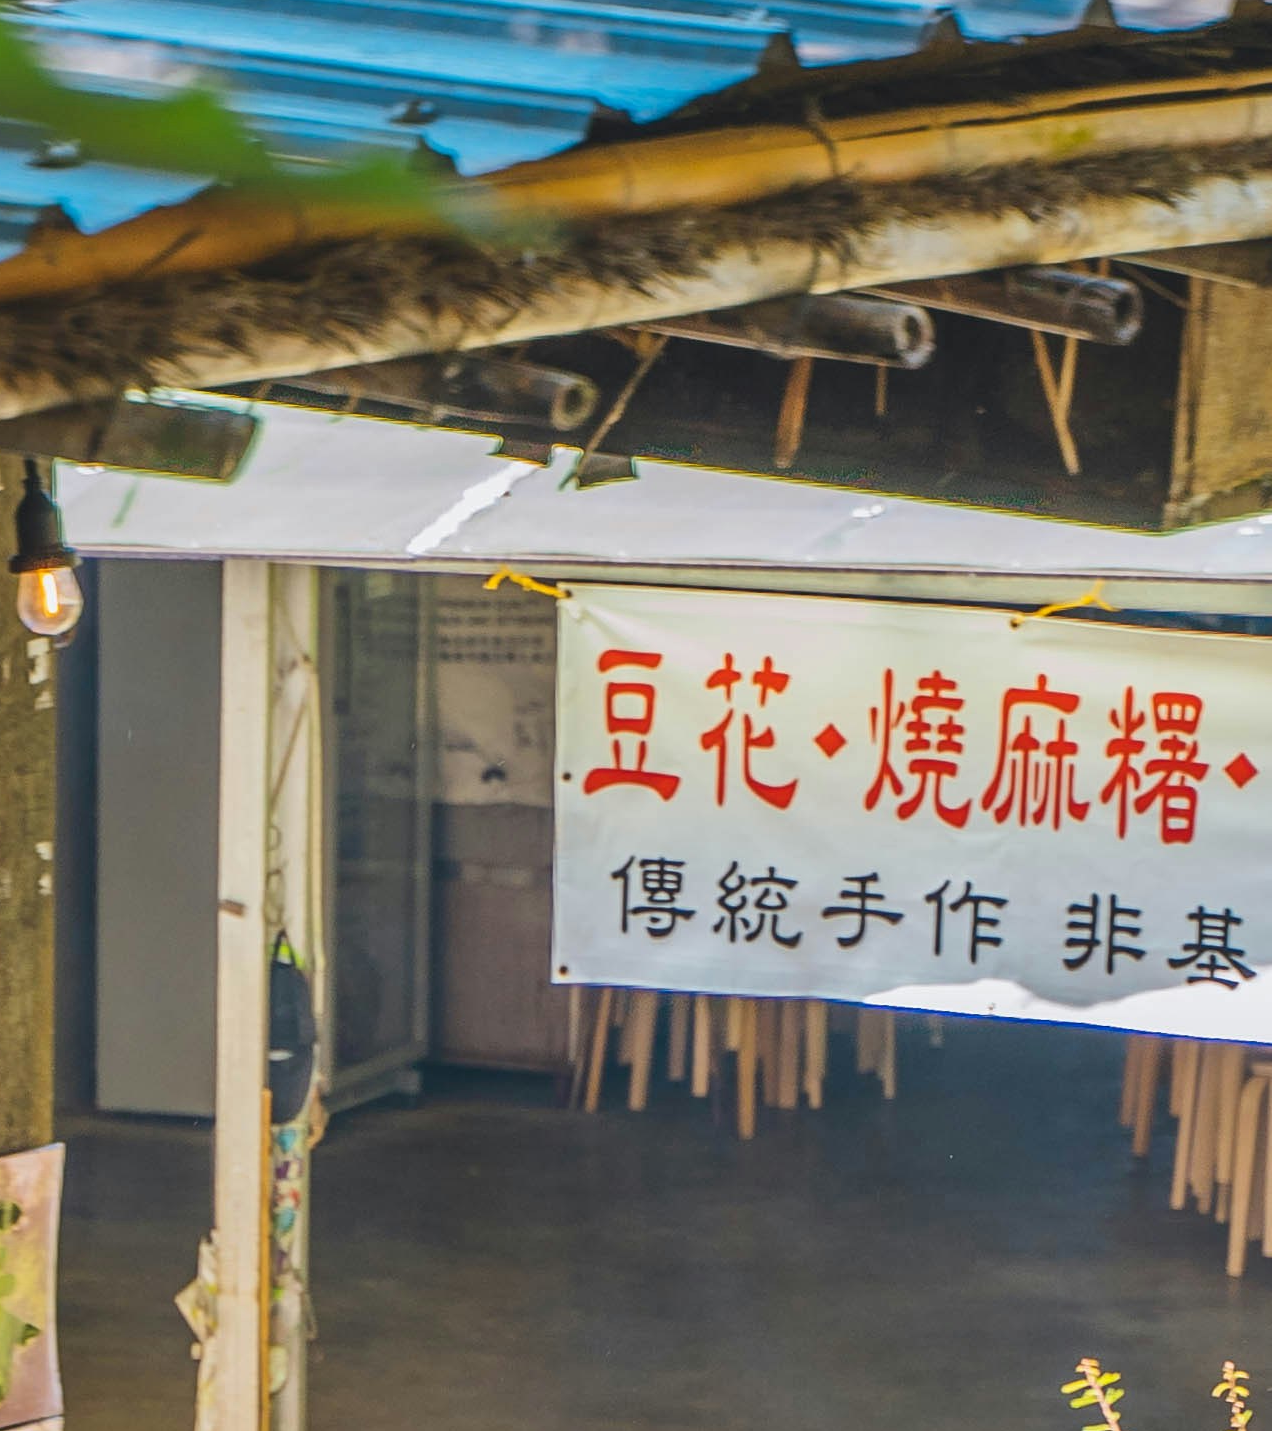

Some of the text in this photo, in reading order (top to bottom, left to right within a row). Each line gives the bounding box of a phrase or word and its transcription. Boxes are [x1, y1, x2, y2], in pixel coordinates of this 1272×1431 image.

[611, 854, 1257, 990] 傳統手作 非基
